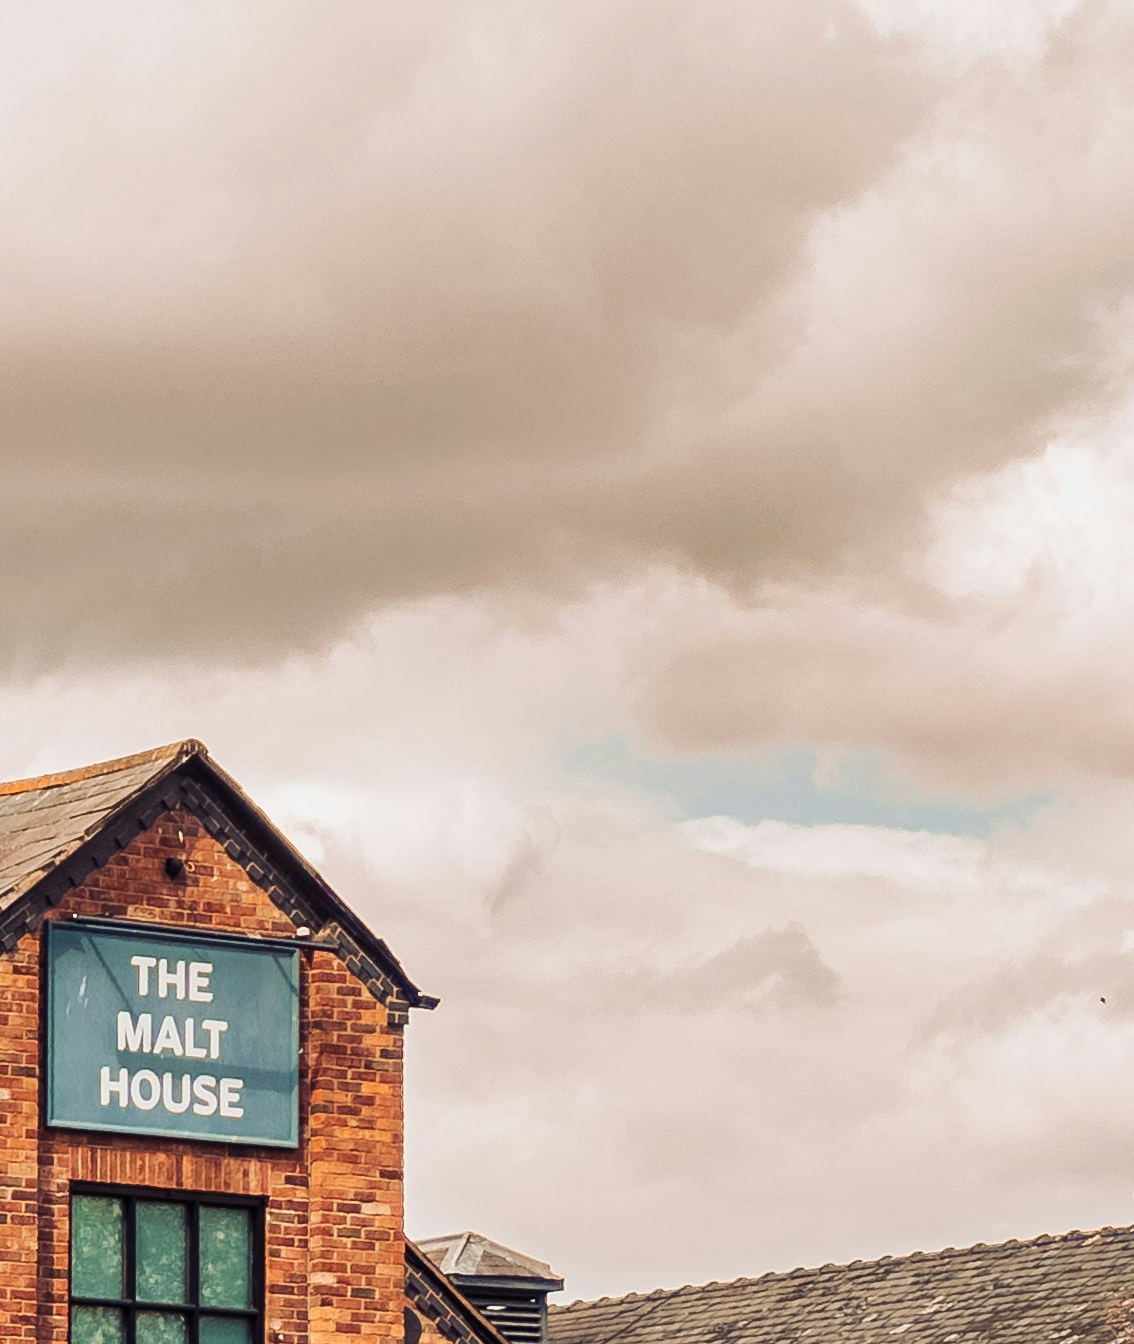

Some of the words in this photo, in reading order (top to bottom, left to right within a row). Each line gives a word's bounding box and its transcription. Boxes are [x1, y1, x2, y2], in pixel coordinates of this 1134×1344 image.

[130, 955, 214, 1003] THE
[117, 1011, 229, 1060] MALT
[100, 1066, 244, 1119] HOUSE
